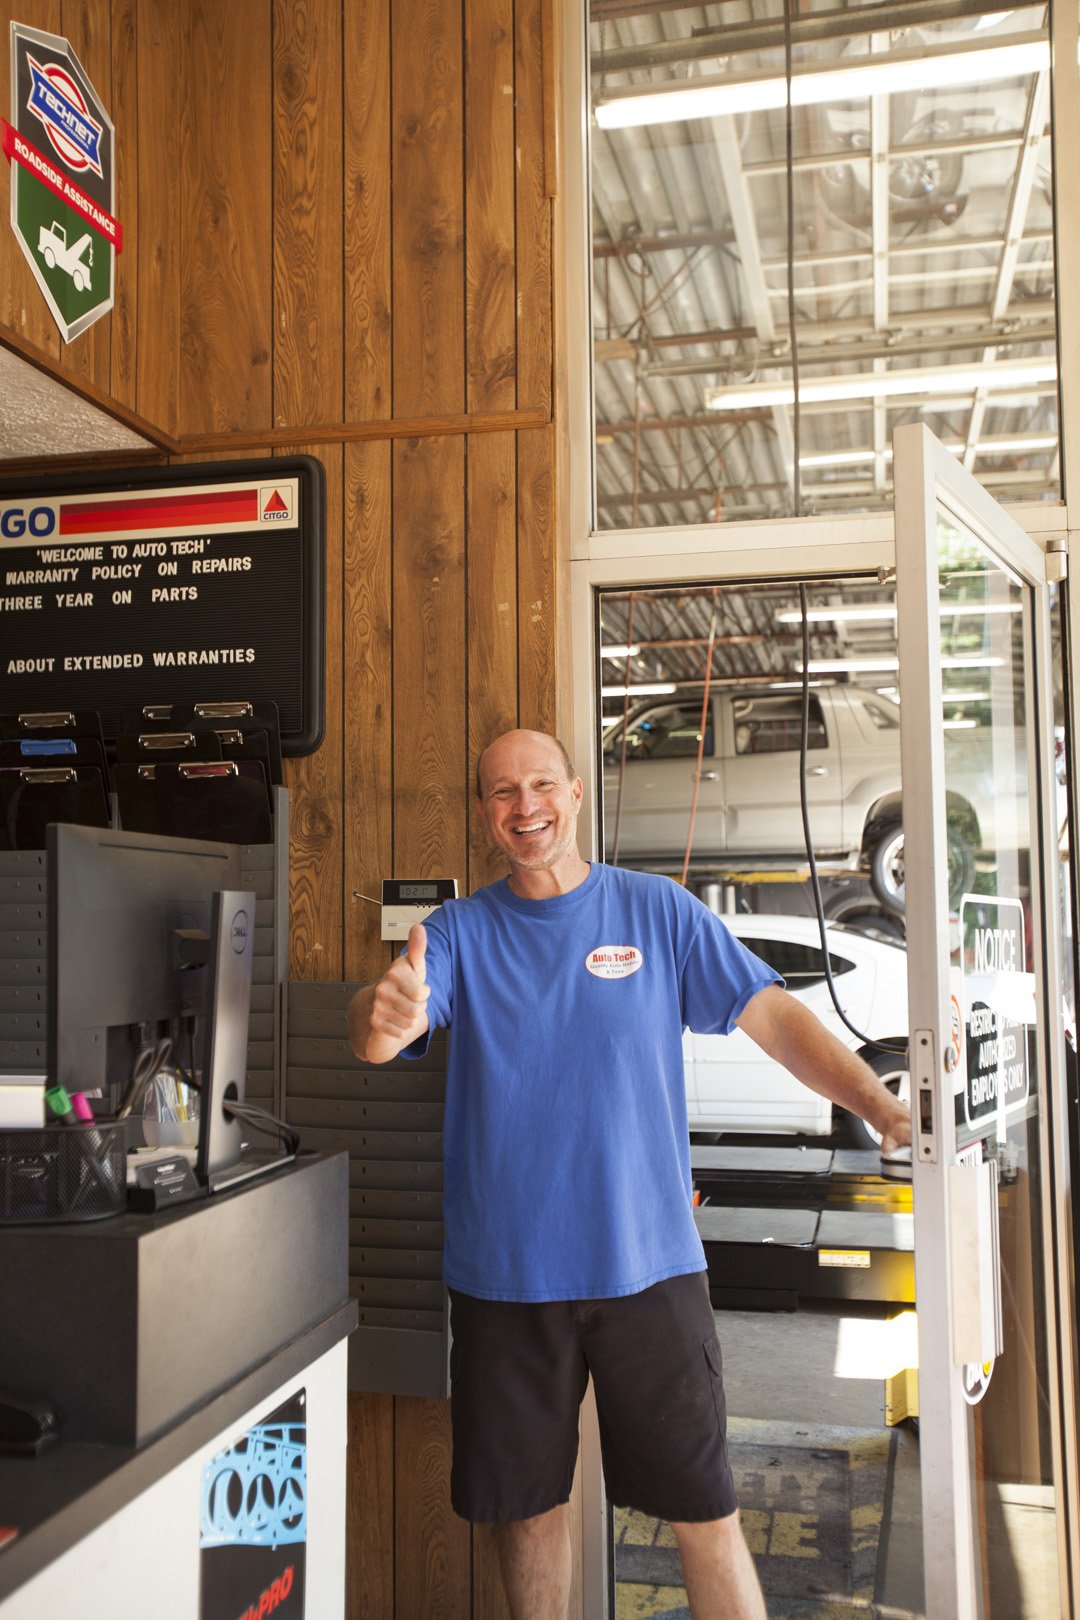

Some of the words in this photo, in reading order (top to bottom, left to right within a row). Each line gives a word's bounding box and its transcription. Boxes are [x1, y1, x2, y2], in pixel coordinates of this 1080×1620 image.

[14, 137, 63, 191] ROADSIDE
[63, 183, 116, 236] ASSISTANCE
[0, 506, 55, 538] GO
[263, 511, 289, 520] CITGO
[111, 545, 127, 559] TO
[132, 542, 167, 557] AUTO
[6, 567, 79, 585] WARRANTY
[91, 564, 142, 581] POLICY
[158, 561, 177, 576] ON
[192, 556, 252, 574] REPAIRS
[56, 593, 93, 608] YEAR
[112, 590, 132, 605] ON
[151, 586, 198, 602] PARTS
[7, 658, 55, 674] ABOUT
[63, 653, 143, 671] EXTENDED
[153, 648, 255, 667] WARRANTIES
[592, 953, 612, 963] Auto
[614, 950, 636, 962] Tech
[974, 928, 1017, 973] NOTICE
